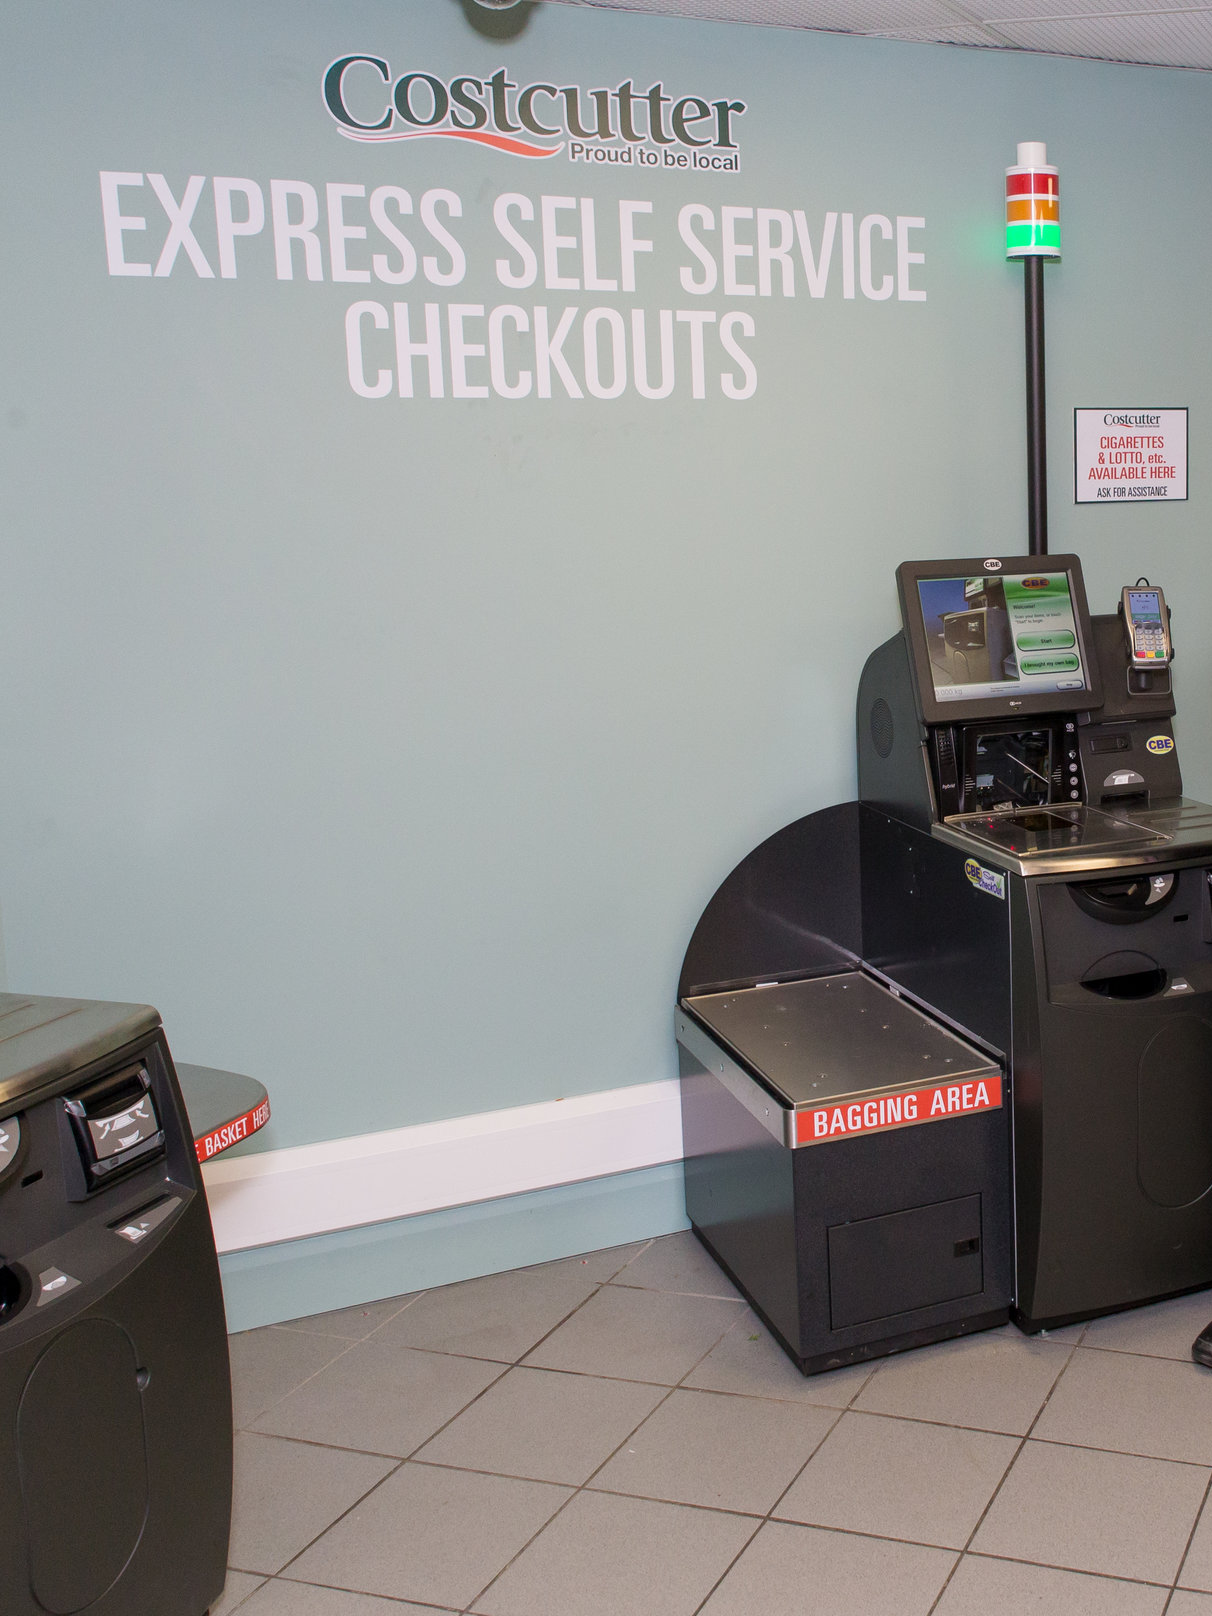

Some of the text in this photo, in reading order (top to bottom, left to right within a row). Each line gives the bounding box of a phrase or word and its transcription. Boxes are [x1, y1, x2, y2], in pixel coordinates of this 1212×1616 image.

[324, 54, 746, 149] Costcutter
[571, 143, 738, 171] Proud to be local
[99, 171, 927, 302] EXPRESS SELF SERVICE
[345, 301, 757, 400] CHECKOUTS
[1104, 414, 1160, 426] Costcutter
[1100, 436, 1164, 449] CIGARETTES
[1098, 452, 1166, 464] & LOTTO, etc.
[1088, 466, 1176, 480] AVAILABLE HERE
[1097, 486, 1167, 498] ASK FOR ASSISTANCE
[1022, 579, 1048, 587] CBE
[1148, 739, 1172, 750] CBE
[966, 863, 981, 880] CBE
[814, 1082, 990, 1137] BAGGING AREA
[205, 1117, 247, 1156] BASKET
[253, 1101, 269, 1129] HERE
